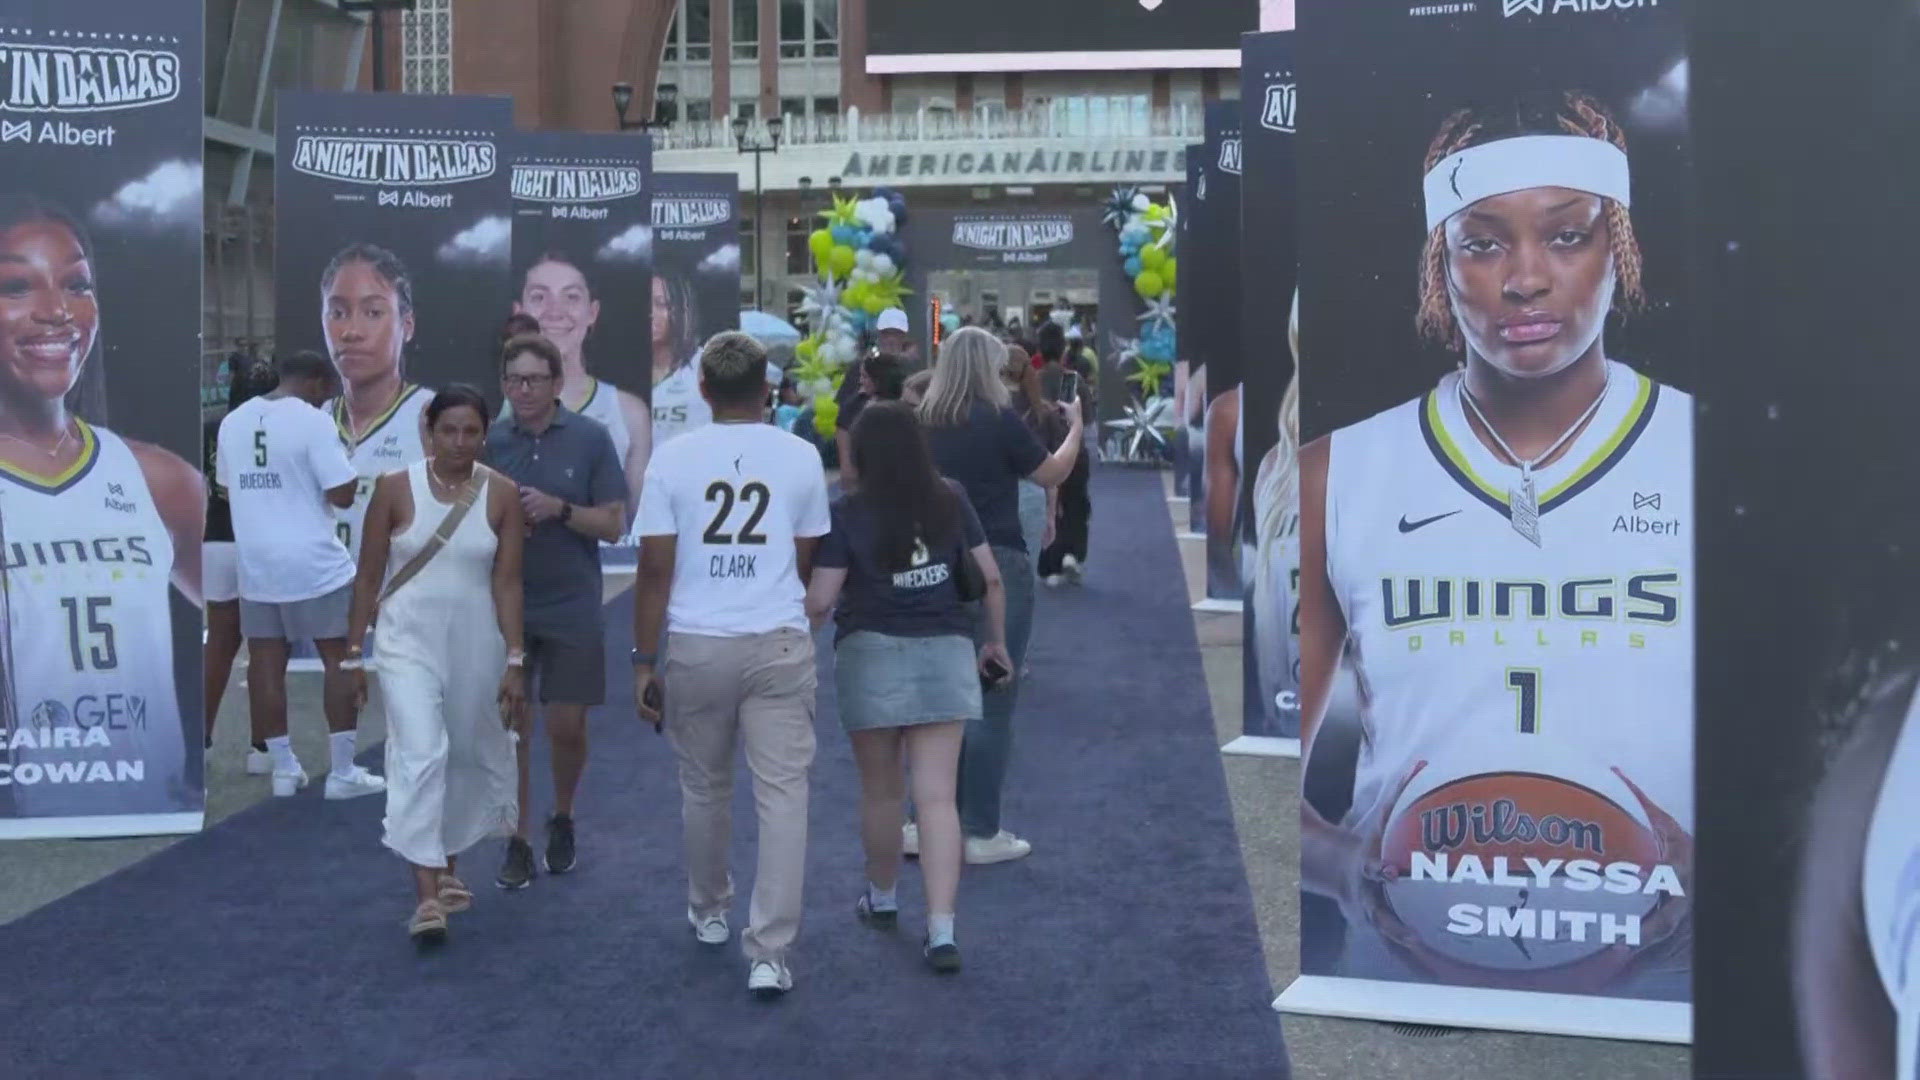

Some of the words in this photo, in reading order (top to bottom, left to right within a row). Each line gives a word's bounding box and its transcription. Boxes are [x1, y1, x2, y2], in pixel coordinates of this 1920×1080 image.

[9, 51, 48, 105] IN
[54, 53, 174, 105] DALLAS
[38, 121, 116, 146] Albert
[297, 141, 312, 169] A
[314, 141, 384, 180] NIGHT
[384, 143, 410, 181] IN
[412, 144, 492, 181] DALLAS
[402, 191, 453, 208] Albert
[556, 170, 576, 198] IN
[578, 170, 637, 198] DALLAS
[570, 206, 608, 219] Albert
[681, 202, 728, 224] DALLAS
[1023, 223, 1070, 246] DALLAS
[254, 430, 267, 467] 5
[703, 480, 770, 545] 22
[1612, 514, 1681, 537] Albert
[709, 554, 757, 579] CLARK
[1380, 572, 1682, 628] WINGS
[60, 595, 118, 671] 15
[1408, 629, 1646, 652] DALLAS
[1505, 666, 1541, 735] 1
[1420, 799, 1606, 856] Wilson
[1410, 851, 1686, 898] NALYSSA
[1446, 903, 1642, 947] SMITH
